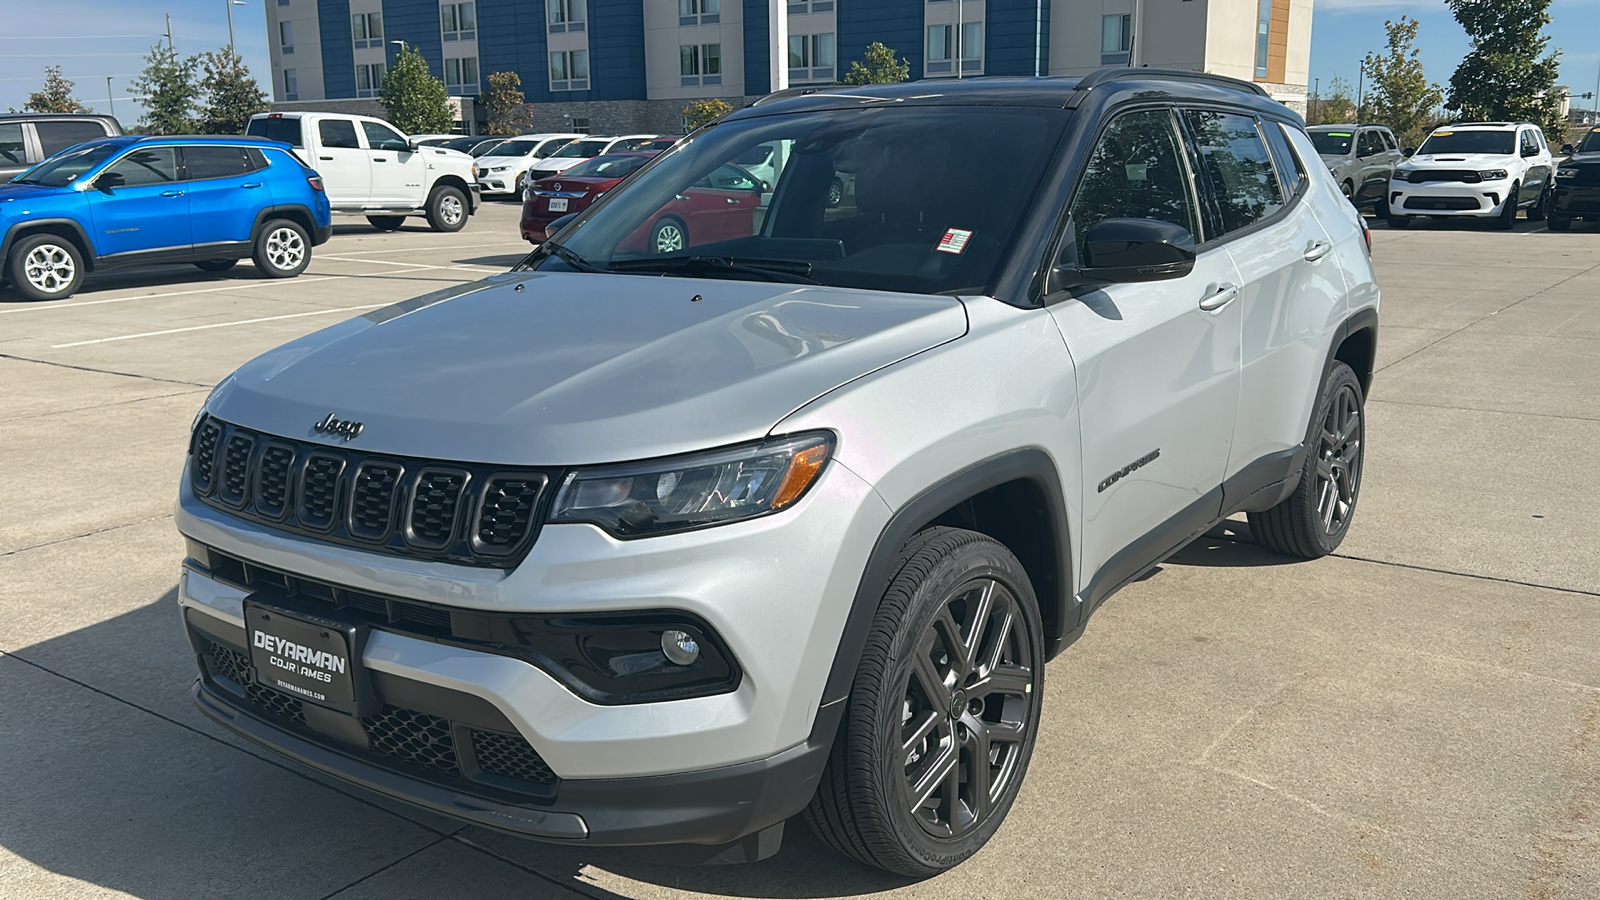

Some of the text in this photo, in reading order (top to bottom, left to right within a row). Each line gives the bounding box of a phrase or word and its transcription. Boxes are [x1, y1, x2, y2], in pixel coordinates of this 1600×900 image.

[314, 413, 364, 442] Jeep
[254, 630, 345, 674] DEYARMAN
[277, 679, 326, 700] DEYARMANAMES.COM
